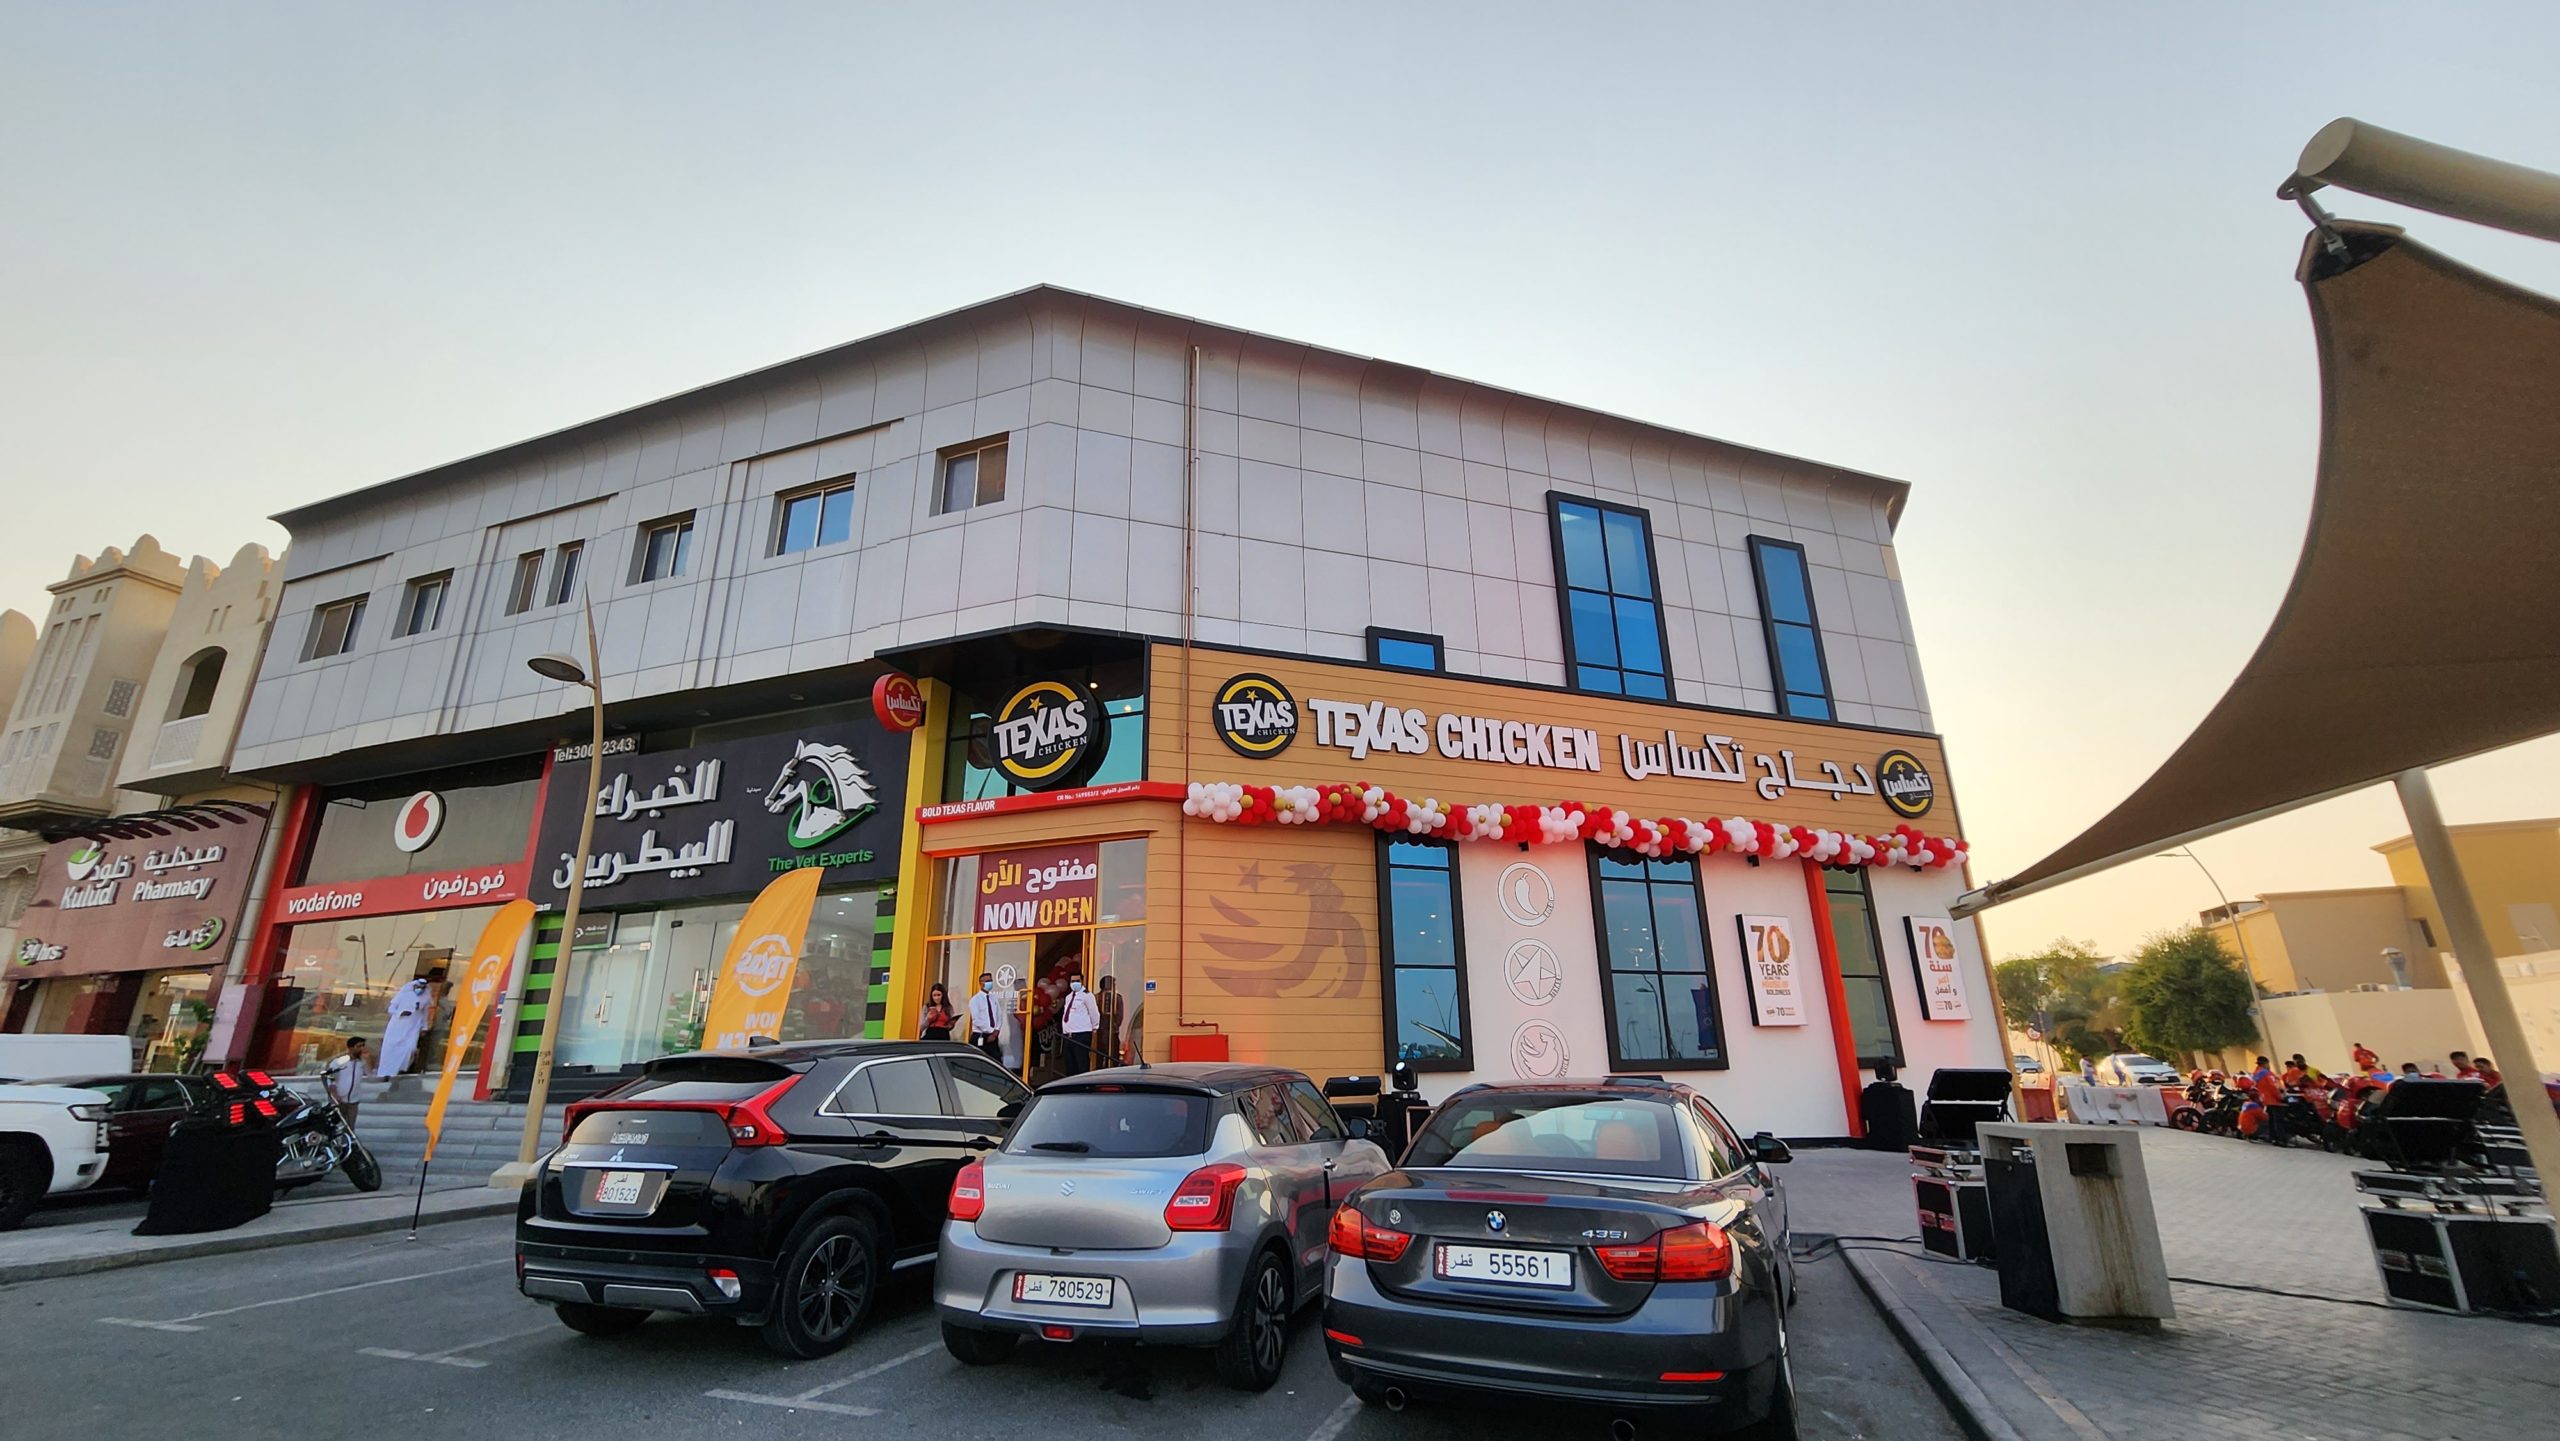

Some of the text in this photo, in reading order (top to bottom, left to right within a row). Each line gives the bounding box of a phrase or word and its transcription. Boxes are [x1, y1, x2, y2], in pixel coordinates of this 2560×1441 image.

[993, 700, 1087, 760] TEXAS
[1217, 699, 1295, 736] TEXAS
[1257, 727, 1296, 736] CHICKEN
[1308, 699, 1602, 772] TEXAS CHICKEN
[1038, 735, 1088, 757] CHICKEN
[1618, 729, 1747, 783] تكساس
[595, 758, 721, 821] الخبراء
[1882, 772, 1931, 797] تكساس
[922, 800, 996, 818] BOLD TEXAS FLAVOR
[89, 844, 224, 887] صيدلية خلود
[767, 849, 875, 871] The Vet Experts
[423, 870, 506, 900] فودافون
[981, 858, 1097, 894] مفتوح الآن
[60, 877, 214, 909] Kulud Pharmacy
[288, 890, 363, 914] vodafone
[983, 896, 1093, 931] NOW OPEN
[1750, 924, 1791, 964] 70
[1759, 963, 1790, 977] YEARS
[1929, 960, 1953, 973] سنة
[1776, 1007, 1786, 1017] 70
[1450, 1253, 1473, 1269] قطر
[1489, 1253, 1551, 1279] 55561
[1024, 1281, 1042, 1294] قطر
[1048, 1280, 1104, 1300] 780529
